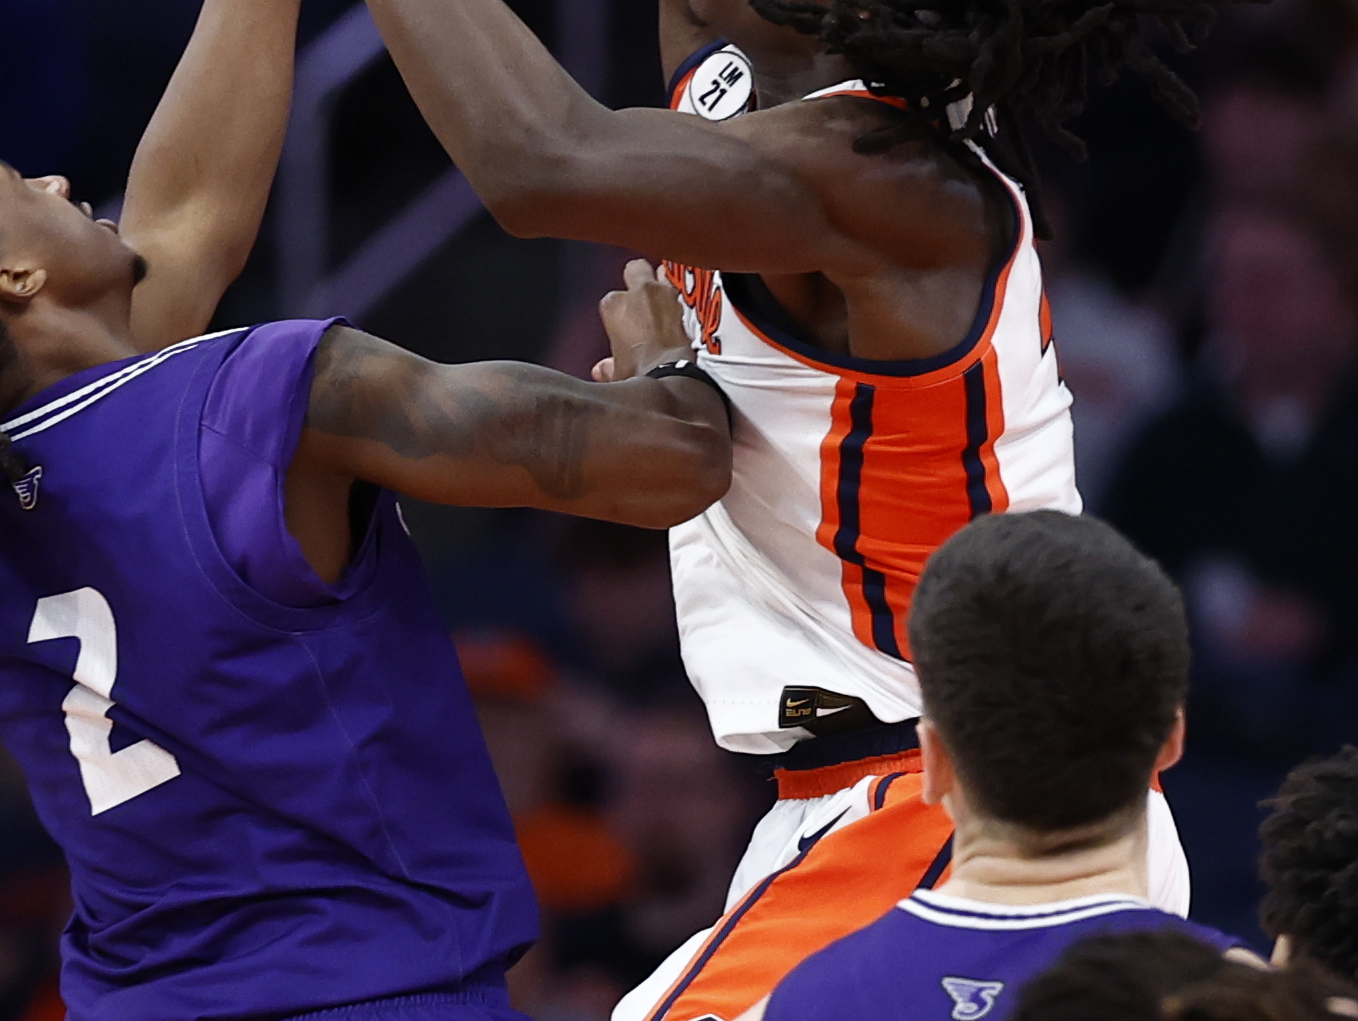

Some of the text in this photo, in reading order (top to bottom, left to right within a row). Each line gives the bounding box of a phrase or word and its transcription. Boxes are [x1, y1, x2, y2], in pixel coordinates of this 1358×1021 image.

[718, 60, 745, 88] LM
[698, 78, 728, 113] 21
[27, 586, 182, 817] 2
